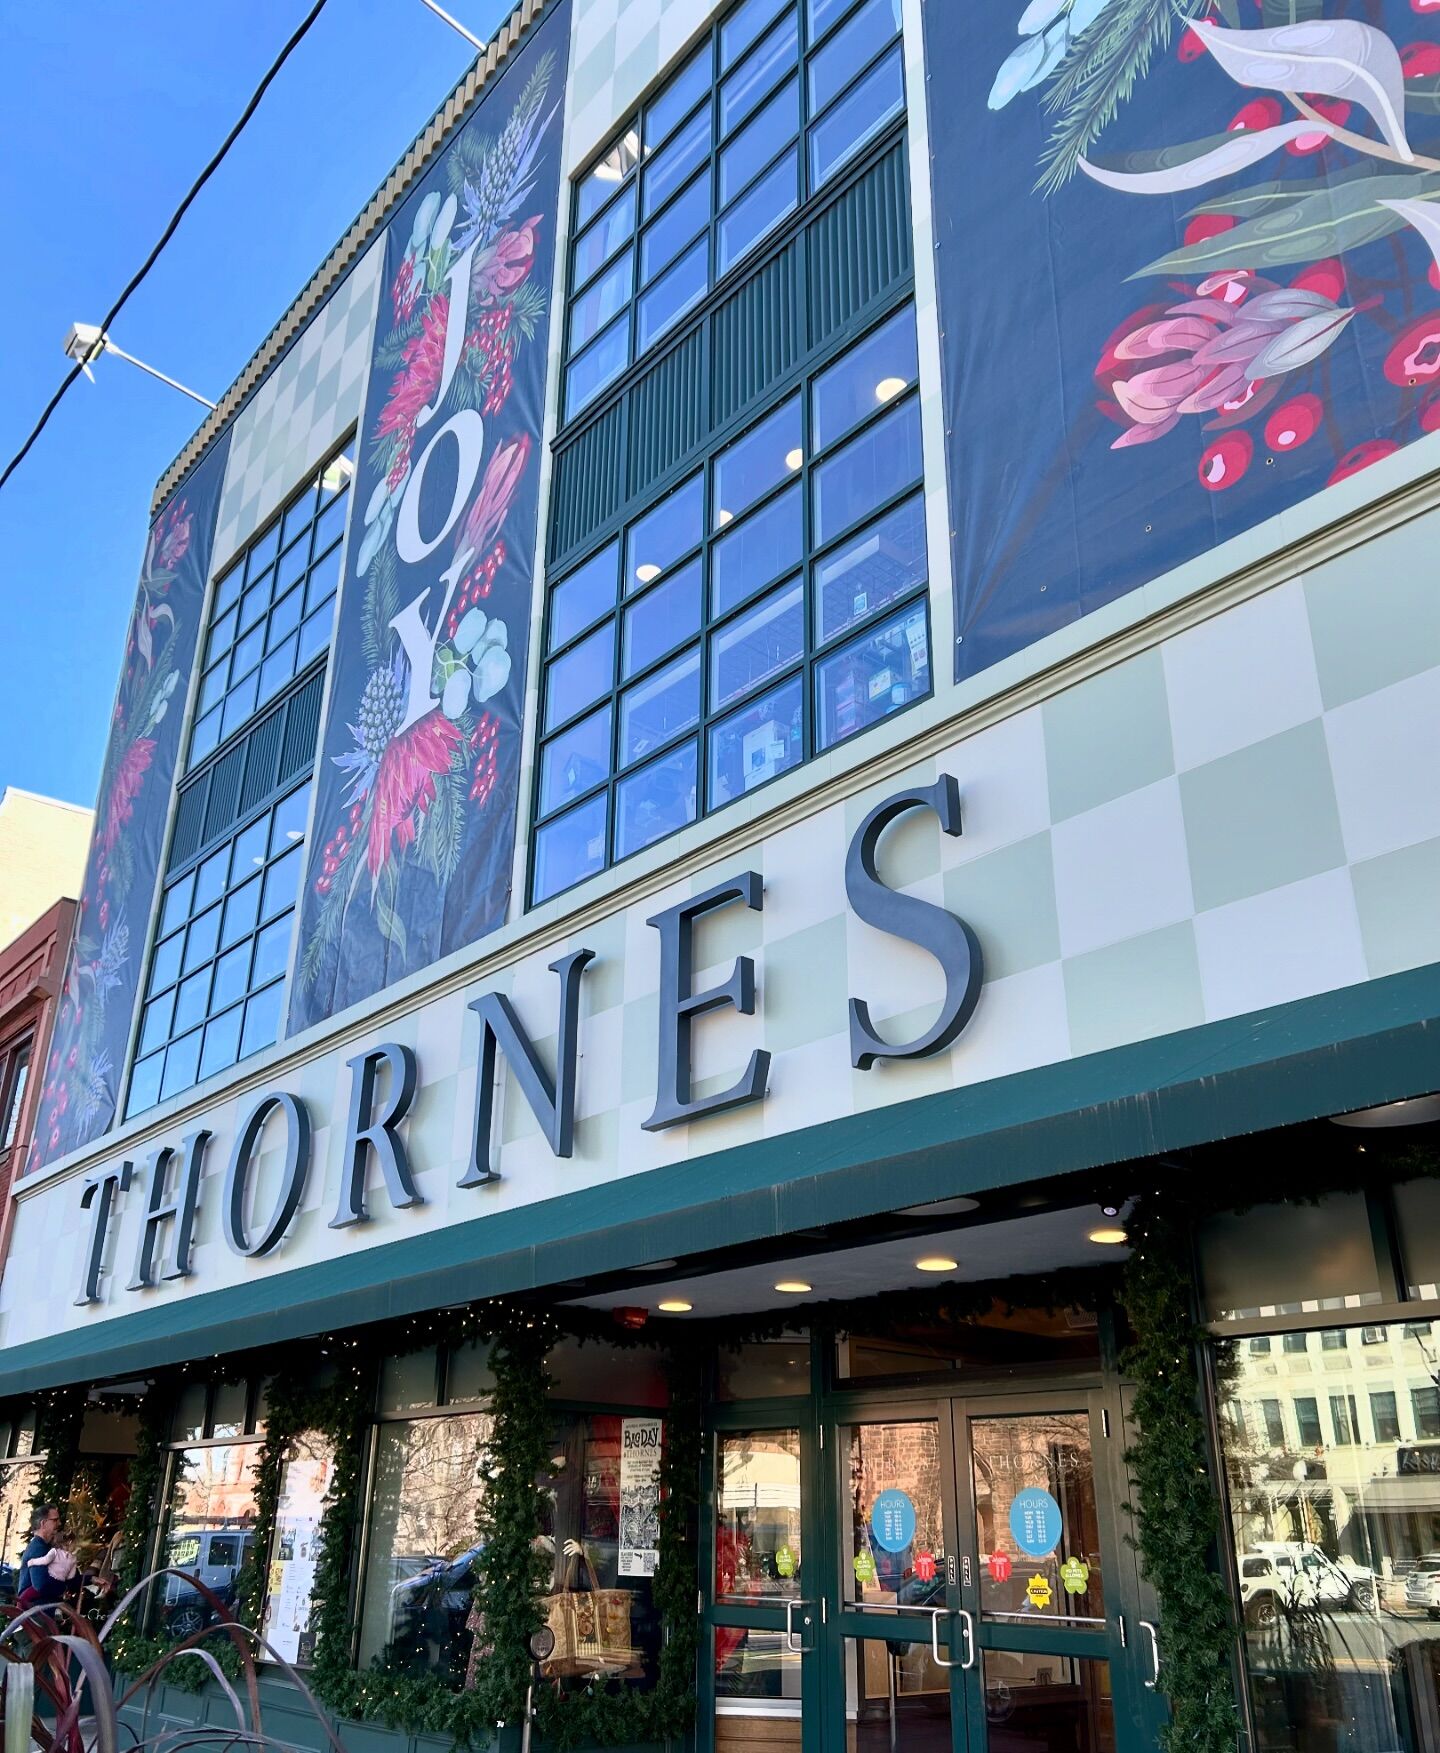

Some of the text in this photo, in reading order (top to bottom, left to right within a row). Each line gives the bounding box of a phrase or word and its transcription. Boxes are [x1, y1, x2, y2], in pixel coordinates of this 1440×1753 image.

[389, 235, 484, 737] JOY
[73, 772, 984, 1307] THORNES
[641, 1427, 659, 1448] DAY
[626, 1448, 657, 1458] THORNES
[988, 1452, 1079, 1471] THORNES
[880, 1499, 905, 1509] HOURS
[1020, 1498, 1049, 1509] HOURS
